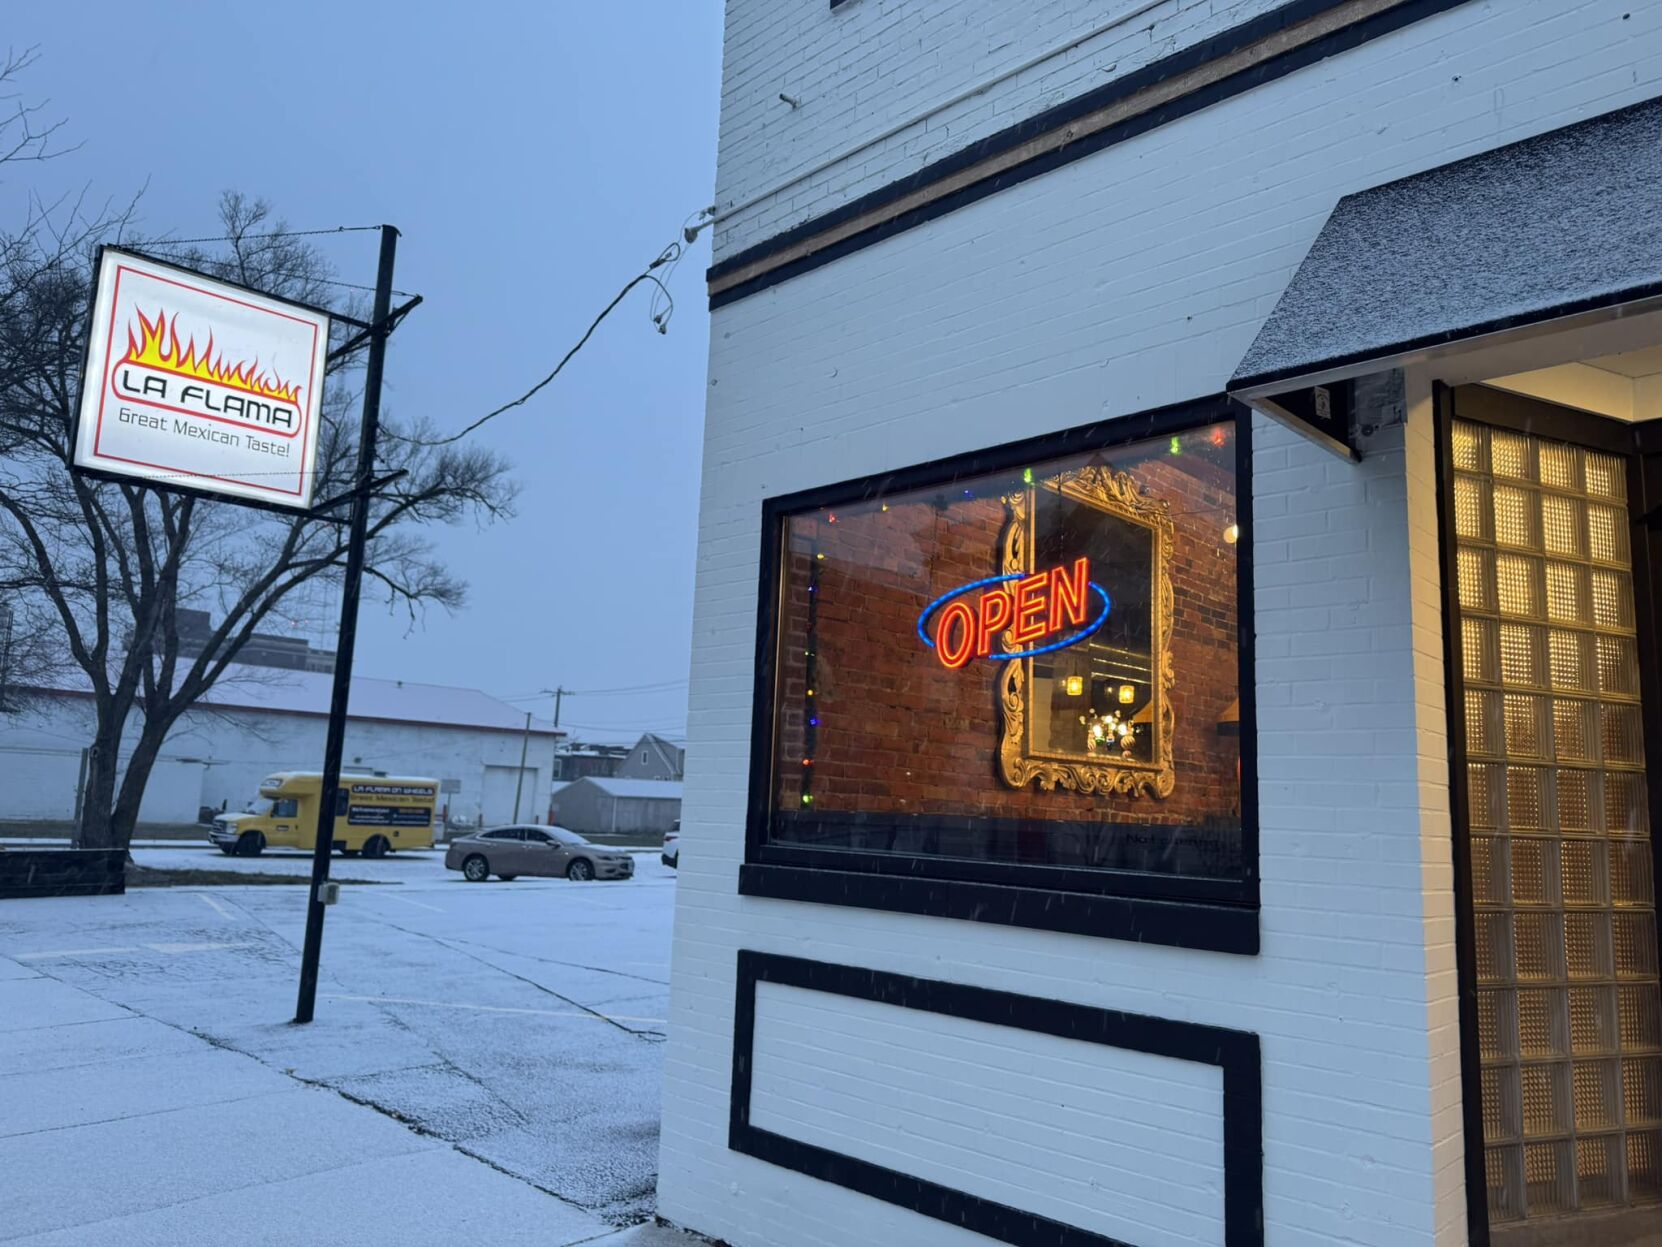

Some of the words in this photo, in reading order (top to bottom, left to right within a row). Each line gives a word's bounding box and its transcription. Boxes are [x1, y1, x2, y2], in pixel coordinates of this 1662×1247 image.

[122, 370, 168, 399] LA
[180, 385, 293, 429] FLAMA
[119, 407, 168, 431] Great
[173, 418, 240, 447] Mexican
[245, 434, 291, 458] Taste!
[936, 556, 1090, 669] OPEN
[353, 785, 365, 793] LA
[403, 787, 433, 795] WHEELS
